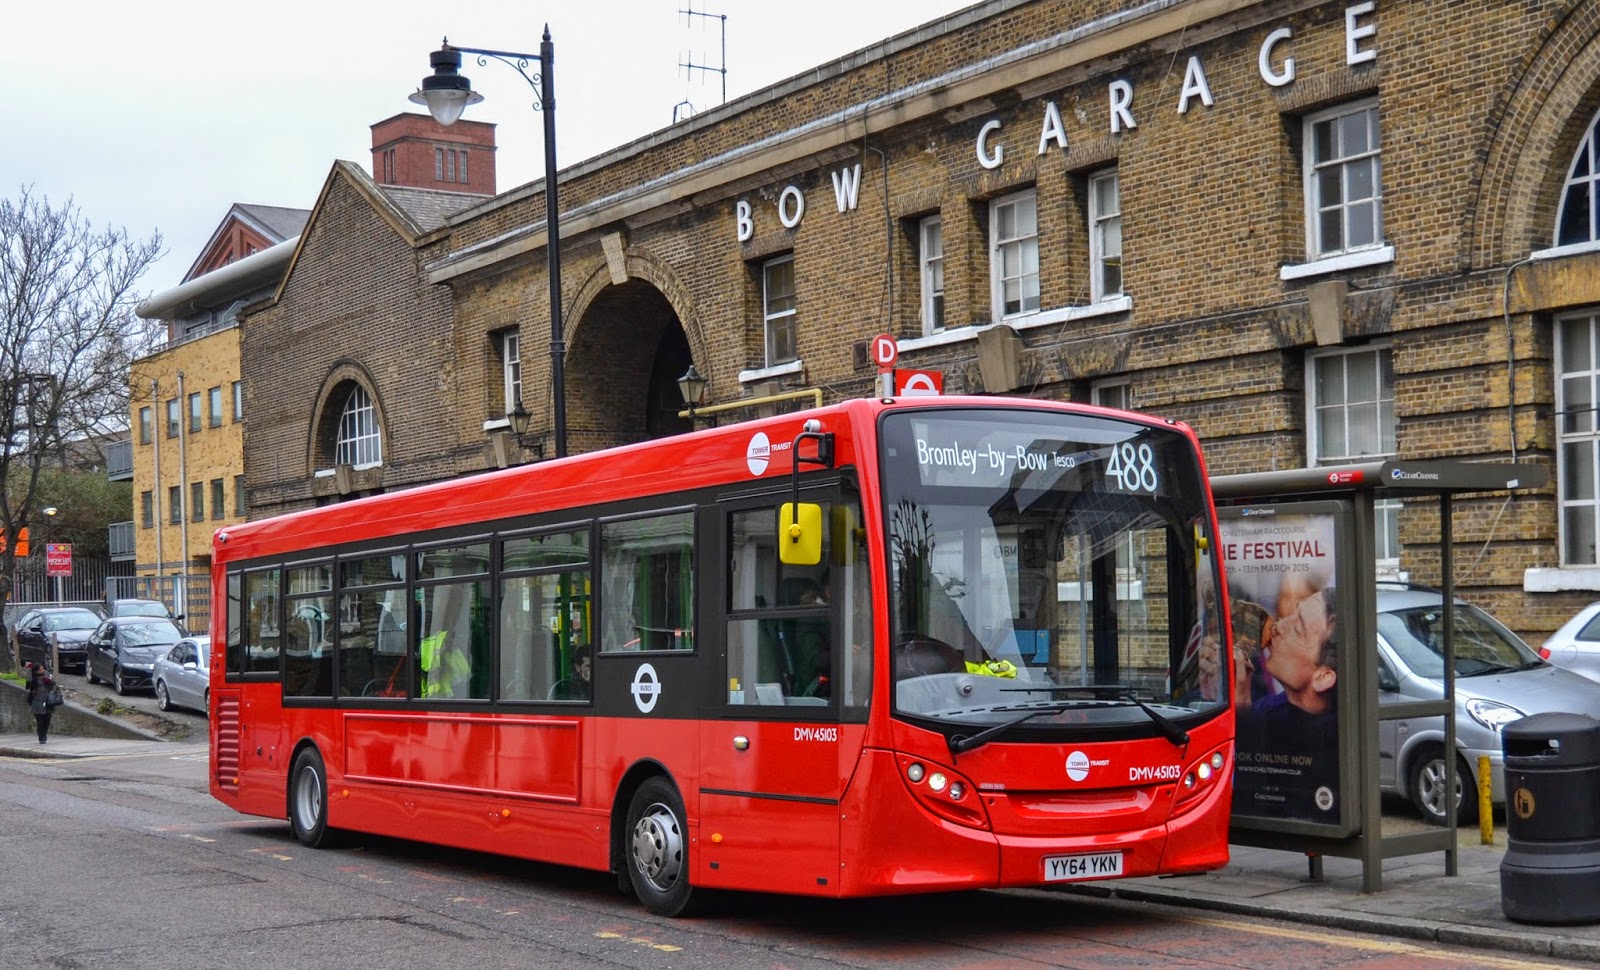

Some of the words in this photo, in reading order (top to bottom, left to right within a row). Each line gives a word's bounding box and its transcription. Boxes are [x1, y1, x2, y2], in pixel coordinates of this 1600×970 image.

[736, 163, 861, 243] BOW
[975, 2, 1378, 169] GARAGE
[879, 339, 895, 363] D
[752, 445, 769, 455] TOWER
[771, 441, 792, 452] TRANSIT
[916, 438, 1047, 476] Bromley-by-Bow
[1051, 452, 1075, 469] Tesco
[1105, 442, 1158, 492] 488
[1223, 528, 1264, 537] CHELTENHAM
[1264, 526, 1306, 535] RACECOURSE
[1243, 540, 1326, 560] FESTIVAL
[1243, 565, 1259, 574] 13th
[1261, 563, 1290, 573] MARCH
[1292, 563, 1309, 572] 2015
[794, 727, 838, 742] DMV45103
[1254, 753, 1290, 764] ONLINE
[1291, 756, 1312, 766] NOW
[1129, 765, 1181, 780] DMV45103
[1051, 858, 1087, 876] YY64
[1091, 855, 1117, 873] YKN
